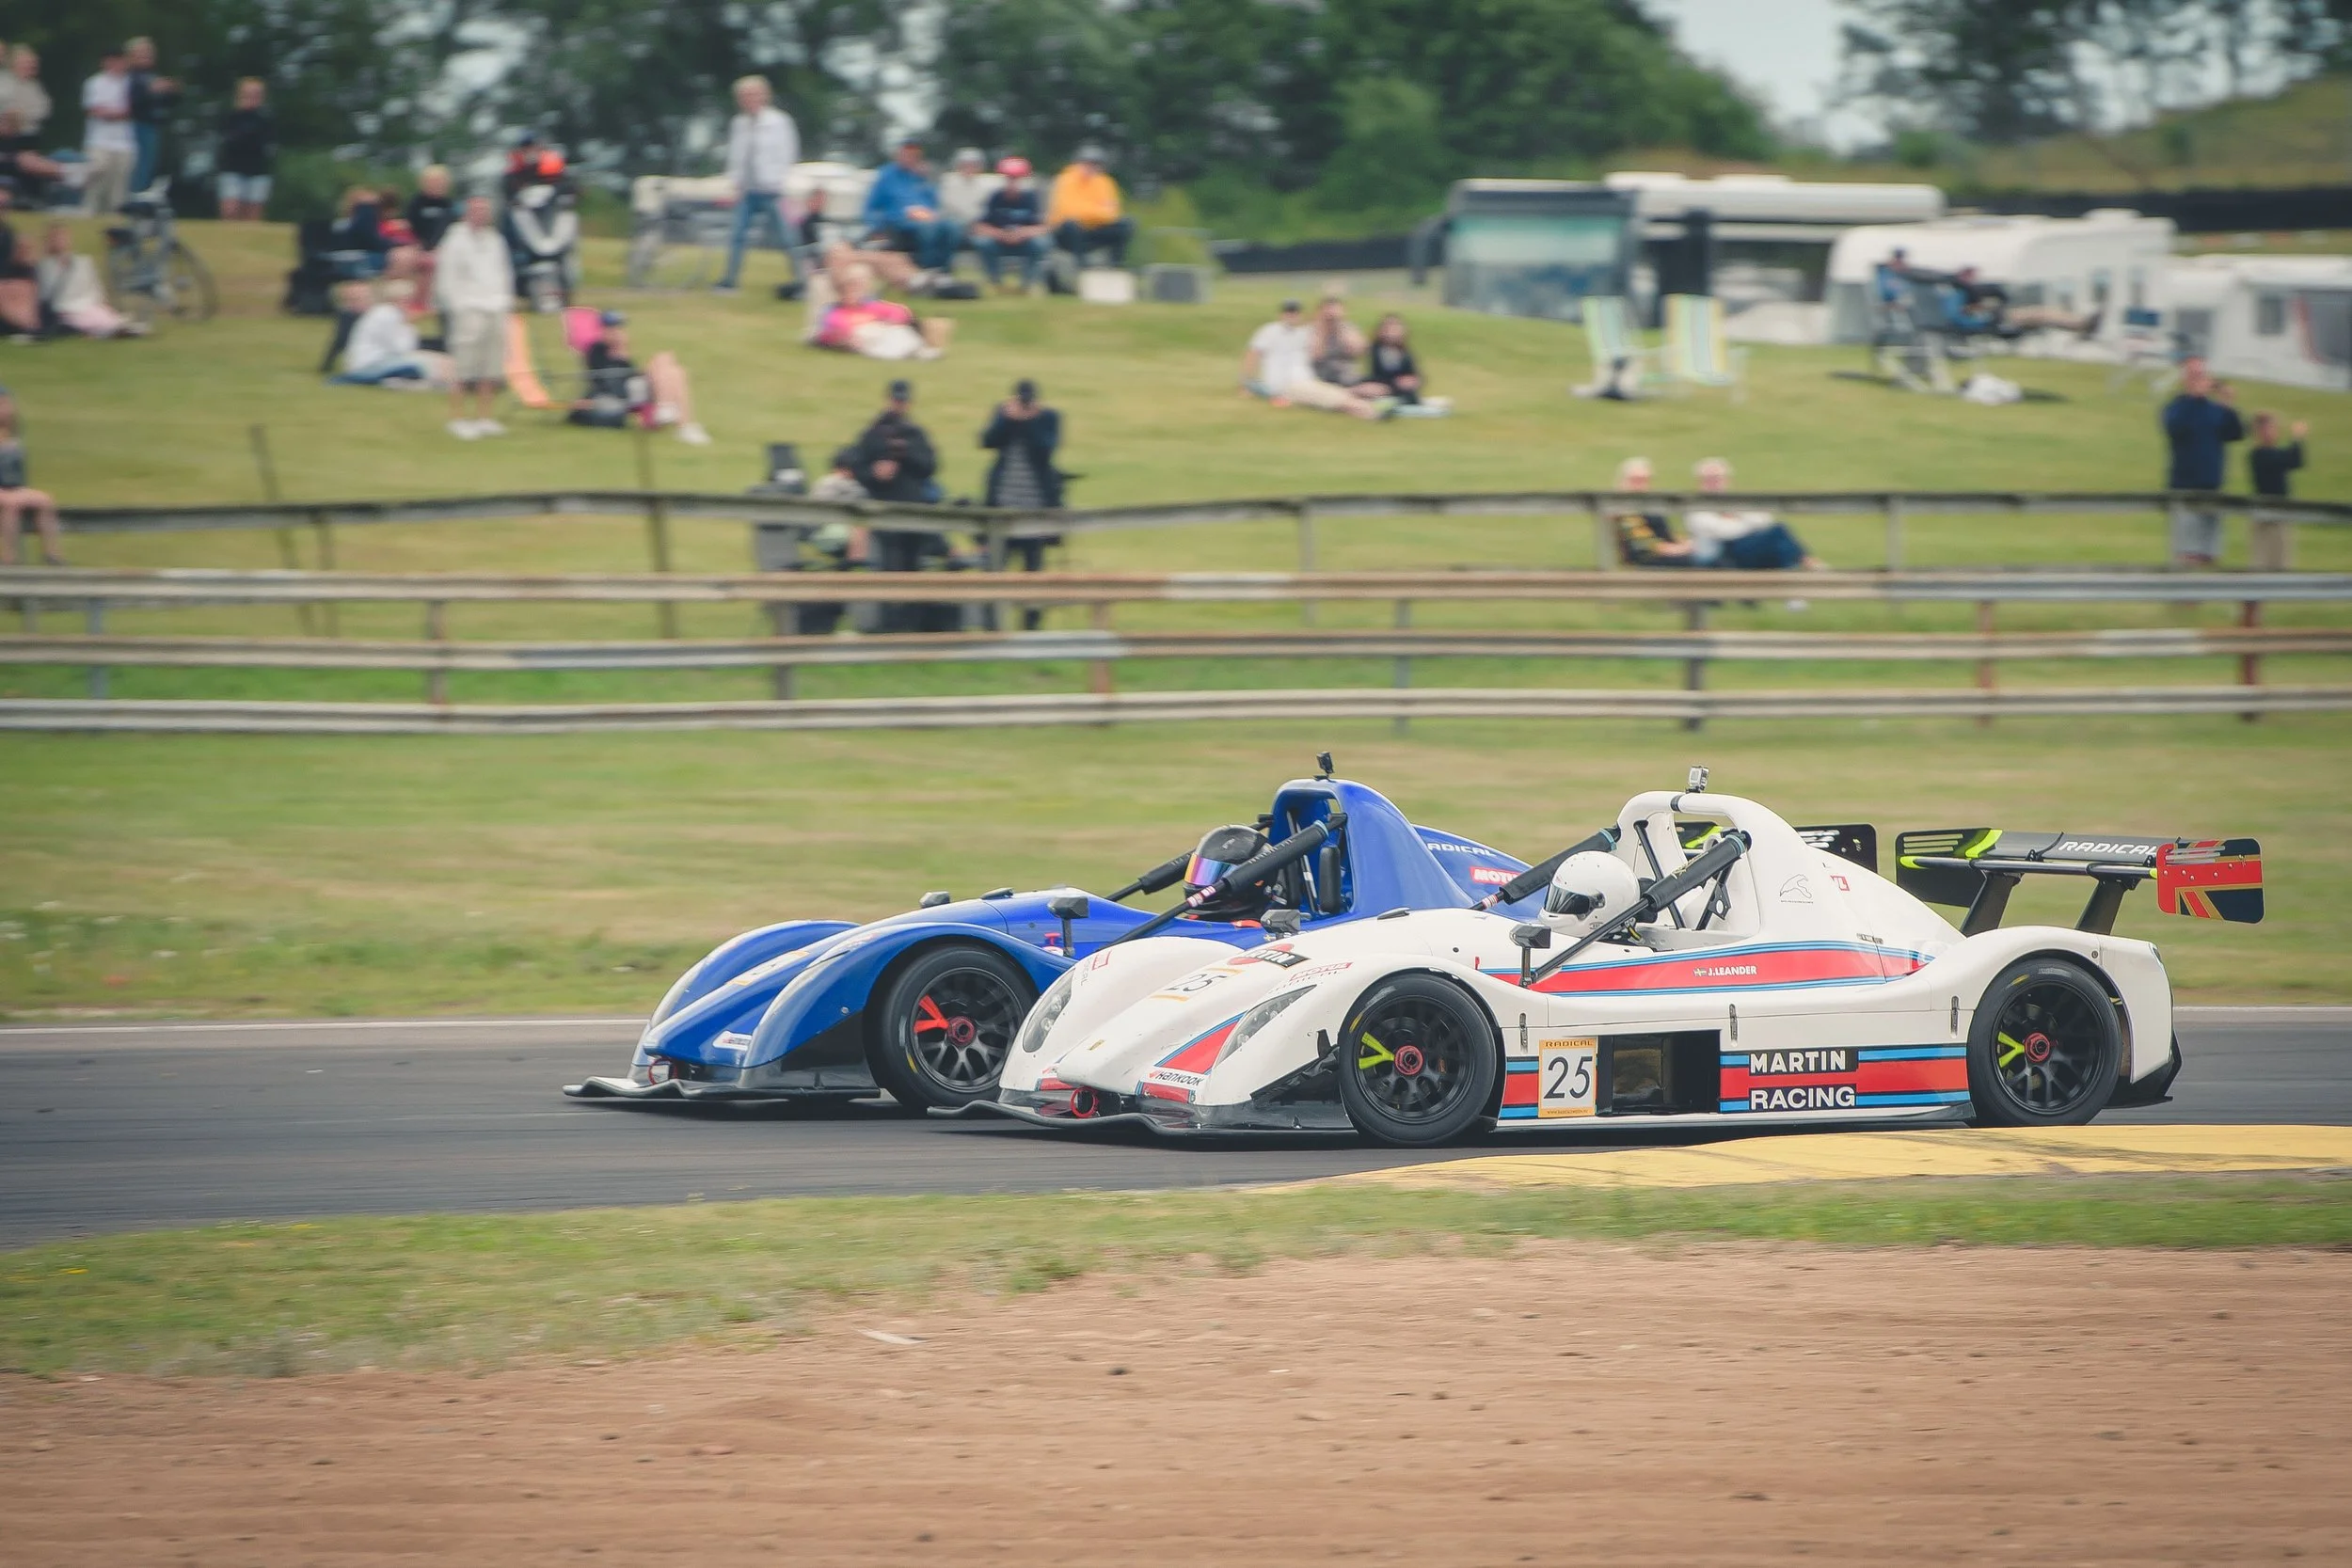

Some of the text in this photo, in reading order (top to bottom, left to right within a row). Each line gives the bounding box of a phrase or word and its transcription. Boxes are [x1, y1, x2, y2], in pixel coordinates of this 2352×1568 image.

[1427, 843, 1497, 857] ADICAL
[2058, 841, 2157, 855] RADICAL
[1708, 964, 1757, 976] J.LEANDER
[1545, 1039, 1593, 1048] RADICAL
[1750, 1051, 1846, 1073] MARTIN
[1543, 1055, 1593, 1100] 25
[1750, 1086, 1855, 1110] RACING
